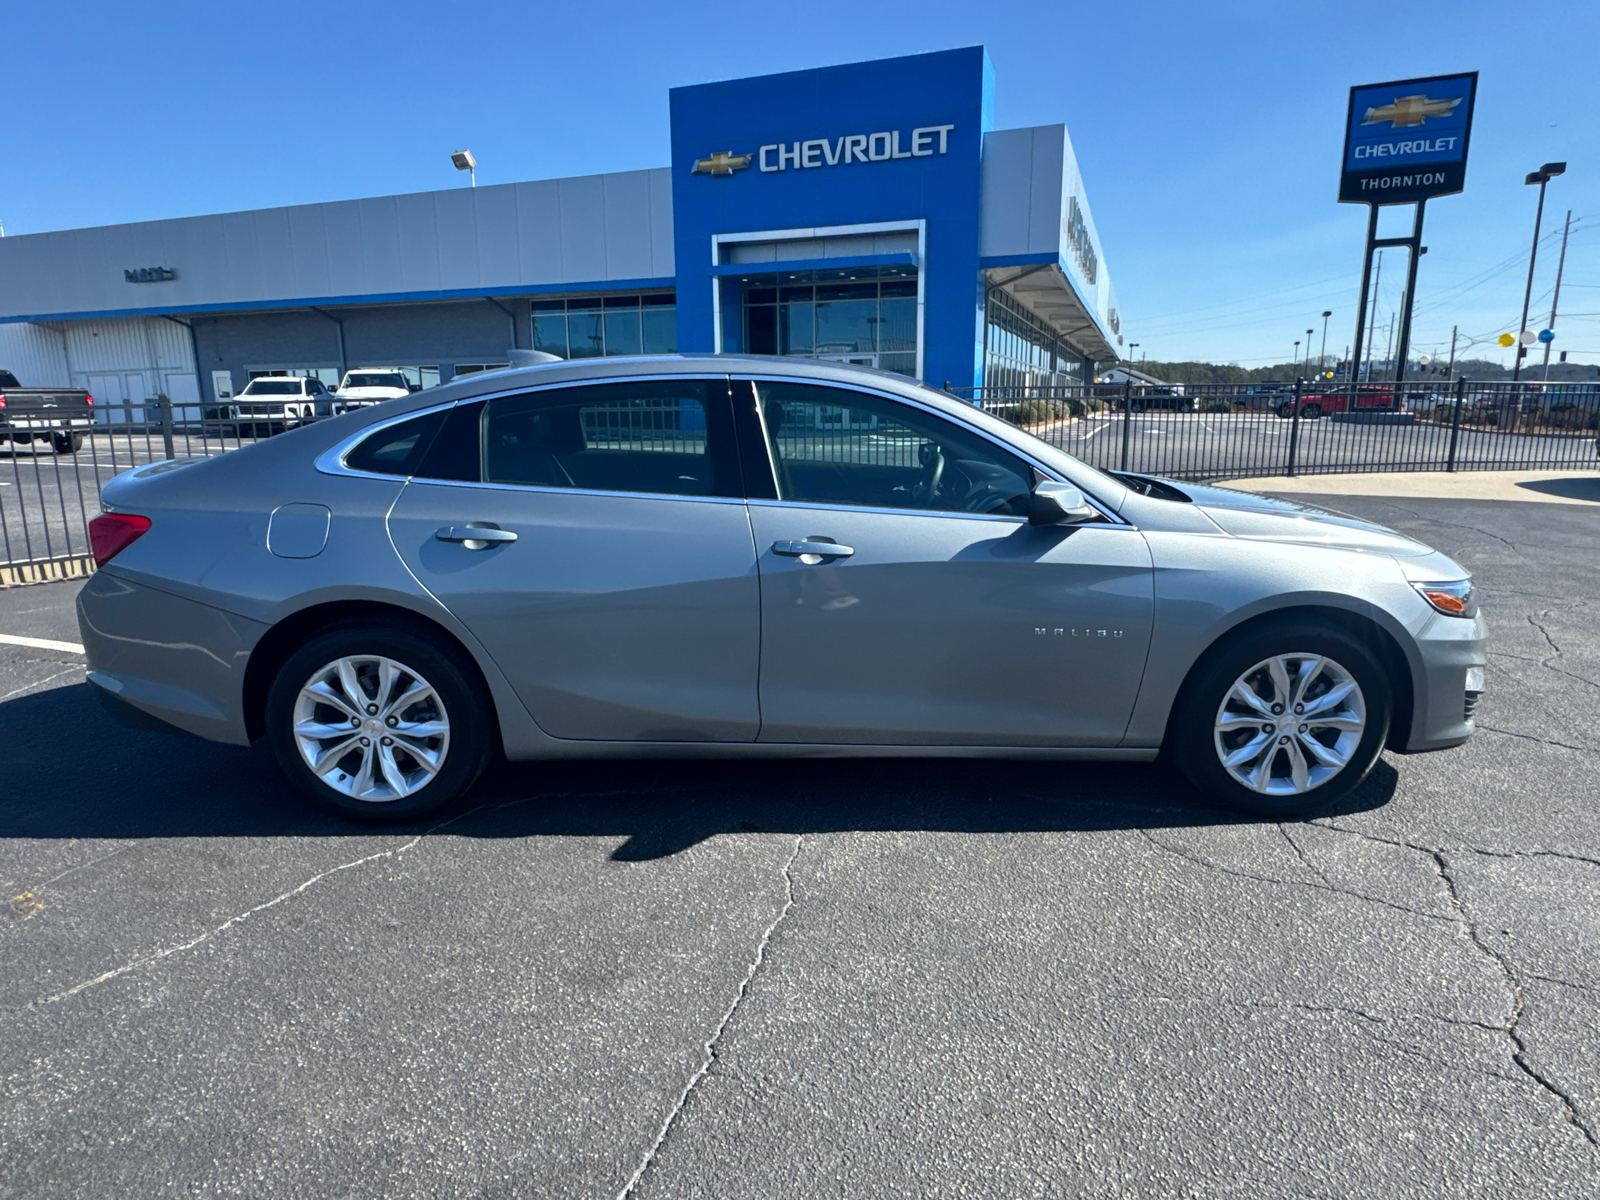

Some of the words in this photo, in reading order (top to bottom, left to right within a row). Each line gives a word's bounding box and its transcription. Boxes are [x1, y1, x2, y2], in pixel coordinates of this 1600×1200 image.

[759, 124, 954, 173] CHEVROLET
[1354, 136, 1458, 159] CHEVROLET
[1360, 172, 1446, 190] THORNTON
[1034, 627, 1124, 638] MALIBU
